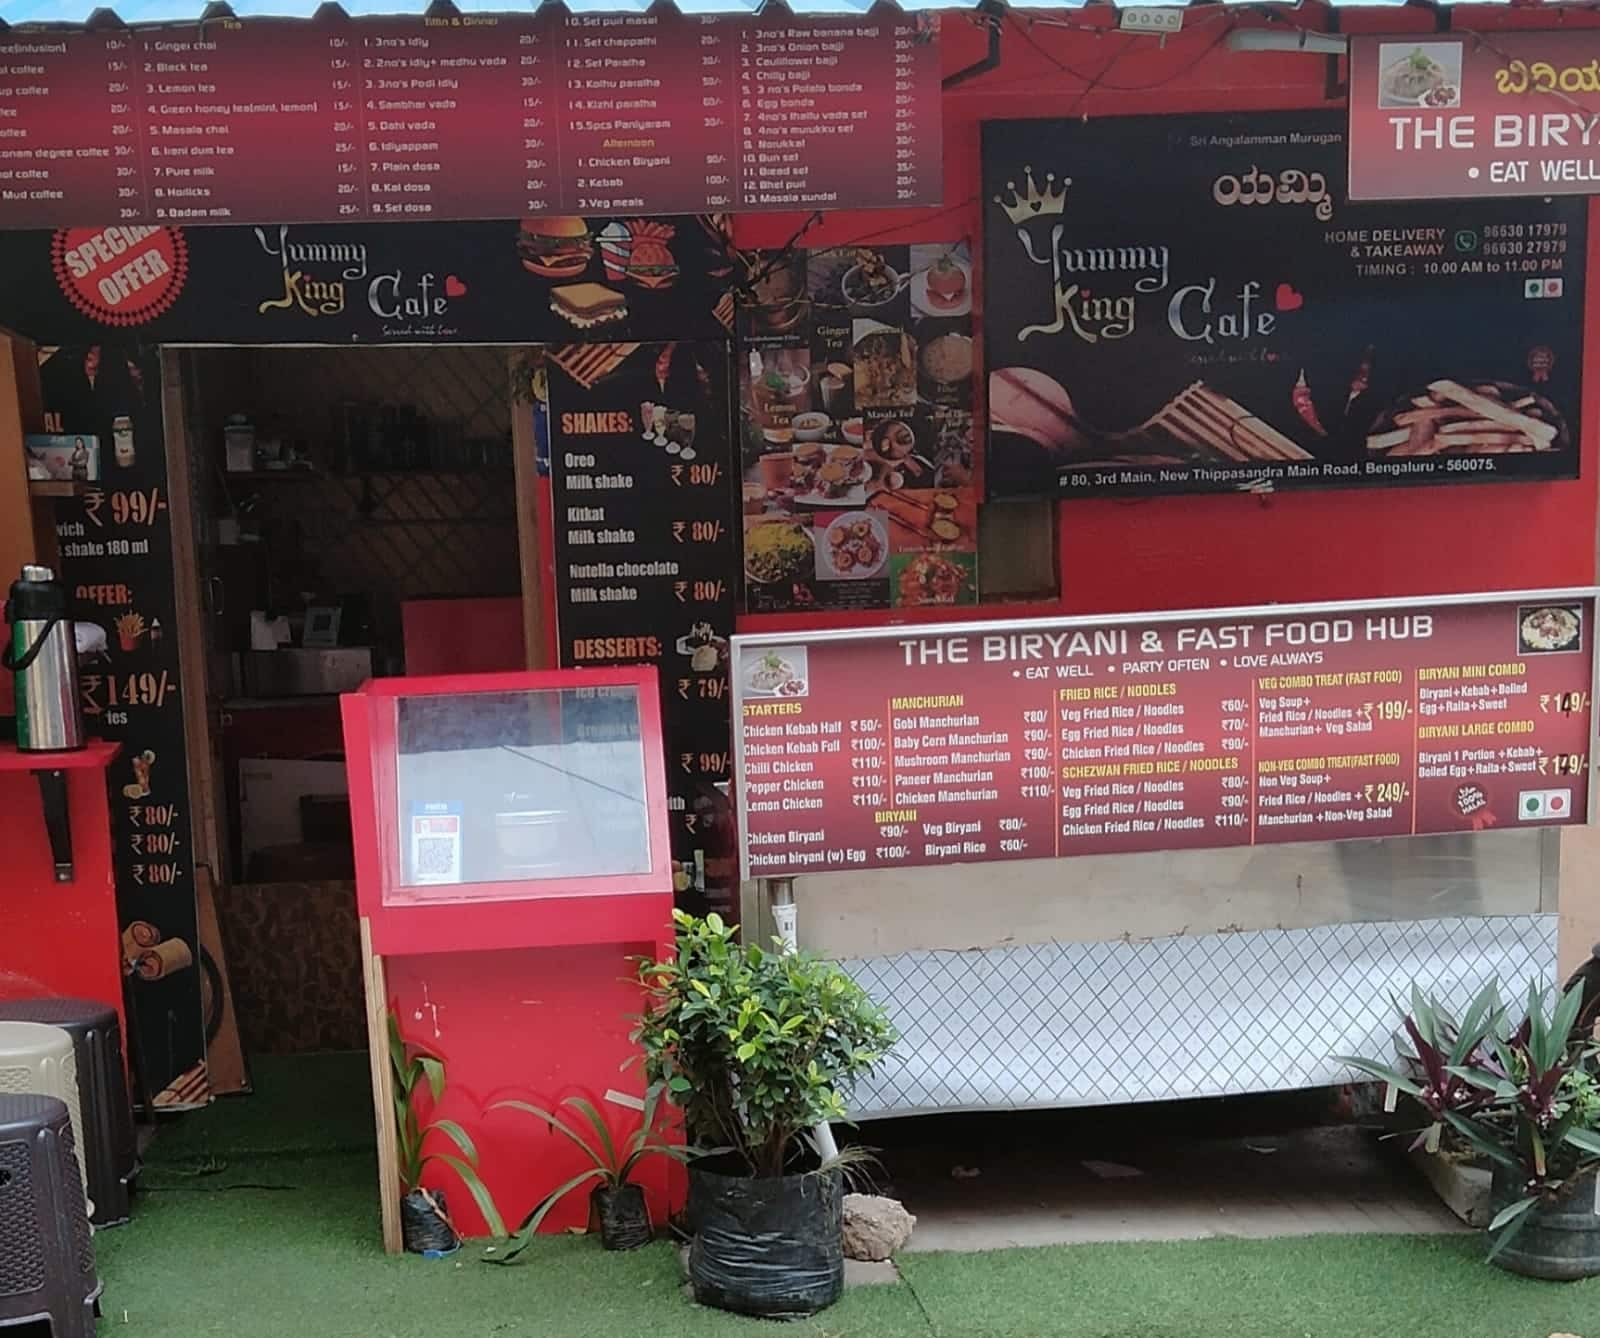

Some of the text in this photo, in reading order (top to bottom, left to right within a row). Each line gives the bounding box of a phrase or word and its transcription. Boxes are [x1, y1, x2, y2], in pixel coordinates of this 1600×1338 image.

[223, 20, 242, 29] Tea
[788, 29, 810, 38] Raw
[156, 62, 208, 72] Black tea
[479, 57, 507, 66] vada
[158, 83, 216, 94] Lemon tea
[758, 99, 778, 109] Egg
[162, 125, 202, 135] Masala
[408, 121, 435, 130] vada
[1389, 113, 1600, 150] THE BIRY
[1190, 132, 1342, 147] Sri Angalamman Murugan
[383, 162, 440, 171] Plain dosa
[589, 158, 631, 167] Chicken
[1490, 160, 1600, 182] EAT WELL
[165, 166, 215, 177] Pure milk
[706, 176, 730, 185] 100/-
[3, 190, 27, 199] Mud
[760, 194, 799, 203] Masala
[169, 207, 232, 218] Badam milk
[404, 203, 432, 212] dosa
[1325, 230, 1367, 243] HOME
[1373, 229, 1445, 241] DELIVERY
[1484, 225, 1523, 237] 96630
[254, 225, 367, 279] Yummy
[1351, 247, 1361, 257] &
[1366, 244, 1444, 257] TAKEAWAY
[1483, 242, 1523, 254] 96630
[1017, 224, 1169, 293] Yummy
[1357, 259, 1562, 276] TIMING 10.00 AM to 11.00 PM
[98, 248, 170, 305] OFFER
[260, 268, 447, 319] King Cafe
[1017, 277, 1276, 344] King Cafe
[562, 412, 633, 434] SHAKES:
[565, 453, 595, 467] Oreo
[566, 462, 722, 489] Milk shake 80/-
[1095, 472, 1116, 486] 3rd
[1160, 470, 1189, 482] New
[1193, 466, 1284, 483] Thippasandra
[1288, 464, 1319, 477] Main
[1323, 463, 1362, 477] Road,
[1365, 461, 1434, 478] Bengaluru
[112, 488, 166, 525] 99/-
[568, 508, 604, 522] Kitkat
[568, 520, 725, 544] Milk shake 80/-
[65, 539, 148, 556] shake 180 ml
[570, 561, 679, 578] Nutella chocolate
[571, 580, 726, 602] Milk shake 80/-
[574, 637, 662, 659] DESSERTS:
[899, 616, 1433, 666] THE BIRYANI & FAST FOOD HUB
[1025, 652, 1323, 679] EAT WELL PARTY OFTEN LOVE ALWAYS
[1419, 663, 1526, 680] BIRYANI MINI COMBO
[107, 670, 176, 706] 149/-
[1259, 670, 1402, 690] VEG COMBO TREAT (FAST FOOD)
[1060, 683, 1176, 701] FRIED RICE NOODLES
[743, 703, 802, 716] STARTERS
[893, 694, 963, 710] MANCHURIAN
[1377, 700, 1412, 720] 199/-
[1061, 704, 1184, 722] Veg Fried Rice Noodles
[744, 725, 783, 737] Chicken
[786, 723, 817, 735] Kebab
[821, 721, 841, 733] Half
[893, 715, 979, 730] Gobi Manchurian
[1419, 720, 1534, 738] BIRYANI LARGE COMBO
[894, 732, 1008, 750] Baby Corn Manchurian
[895, 750, 1011, 768] Mushroom Manchurian
[745, 761, 813, 775] Chilli Chicken
[1062, 757, 1238, 779] SCHEZWAN FRIED RICE NOODLES
[895, 770, 992, 786] Paneer Manchurian
[746, 780, 824, 796] Pepper Chicken
[1377, 782, 1409, 802] 249/-
[145, 804, 178, 826] 80/-
[875, 809, 917, 823] BIRYANI
[788, 820, 981, 844] Biryani Veg Biryani
[147, 832, 179, 854] 80/-
[789, 852, 824, 864] biryani
[847, 849, 866, 862] Egg
[925, 843, 961, 857] Biryani
[964, 841, 986, 854] Rice
[149, 862, 182, 884] 80/-
